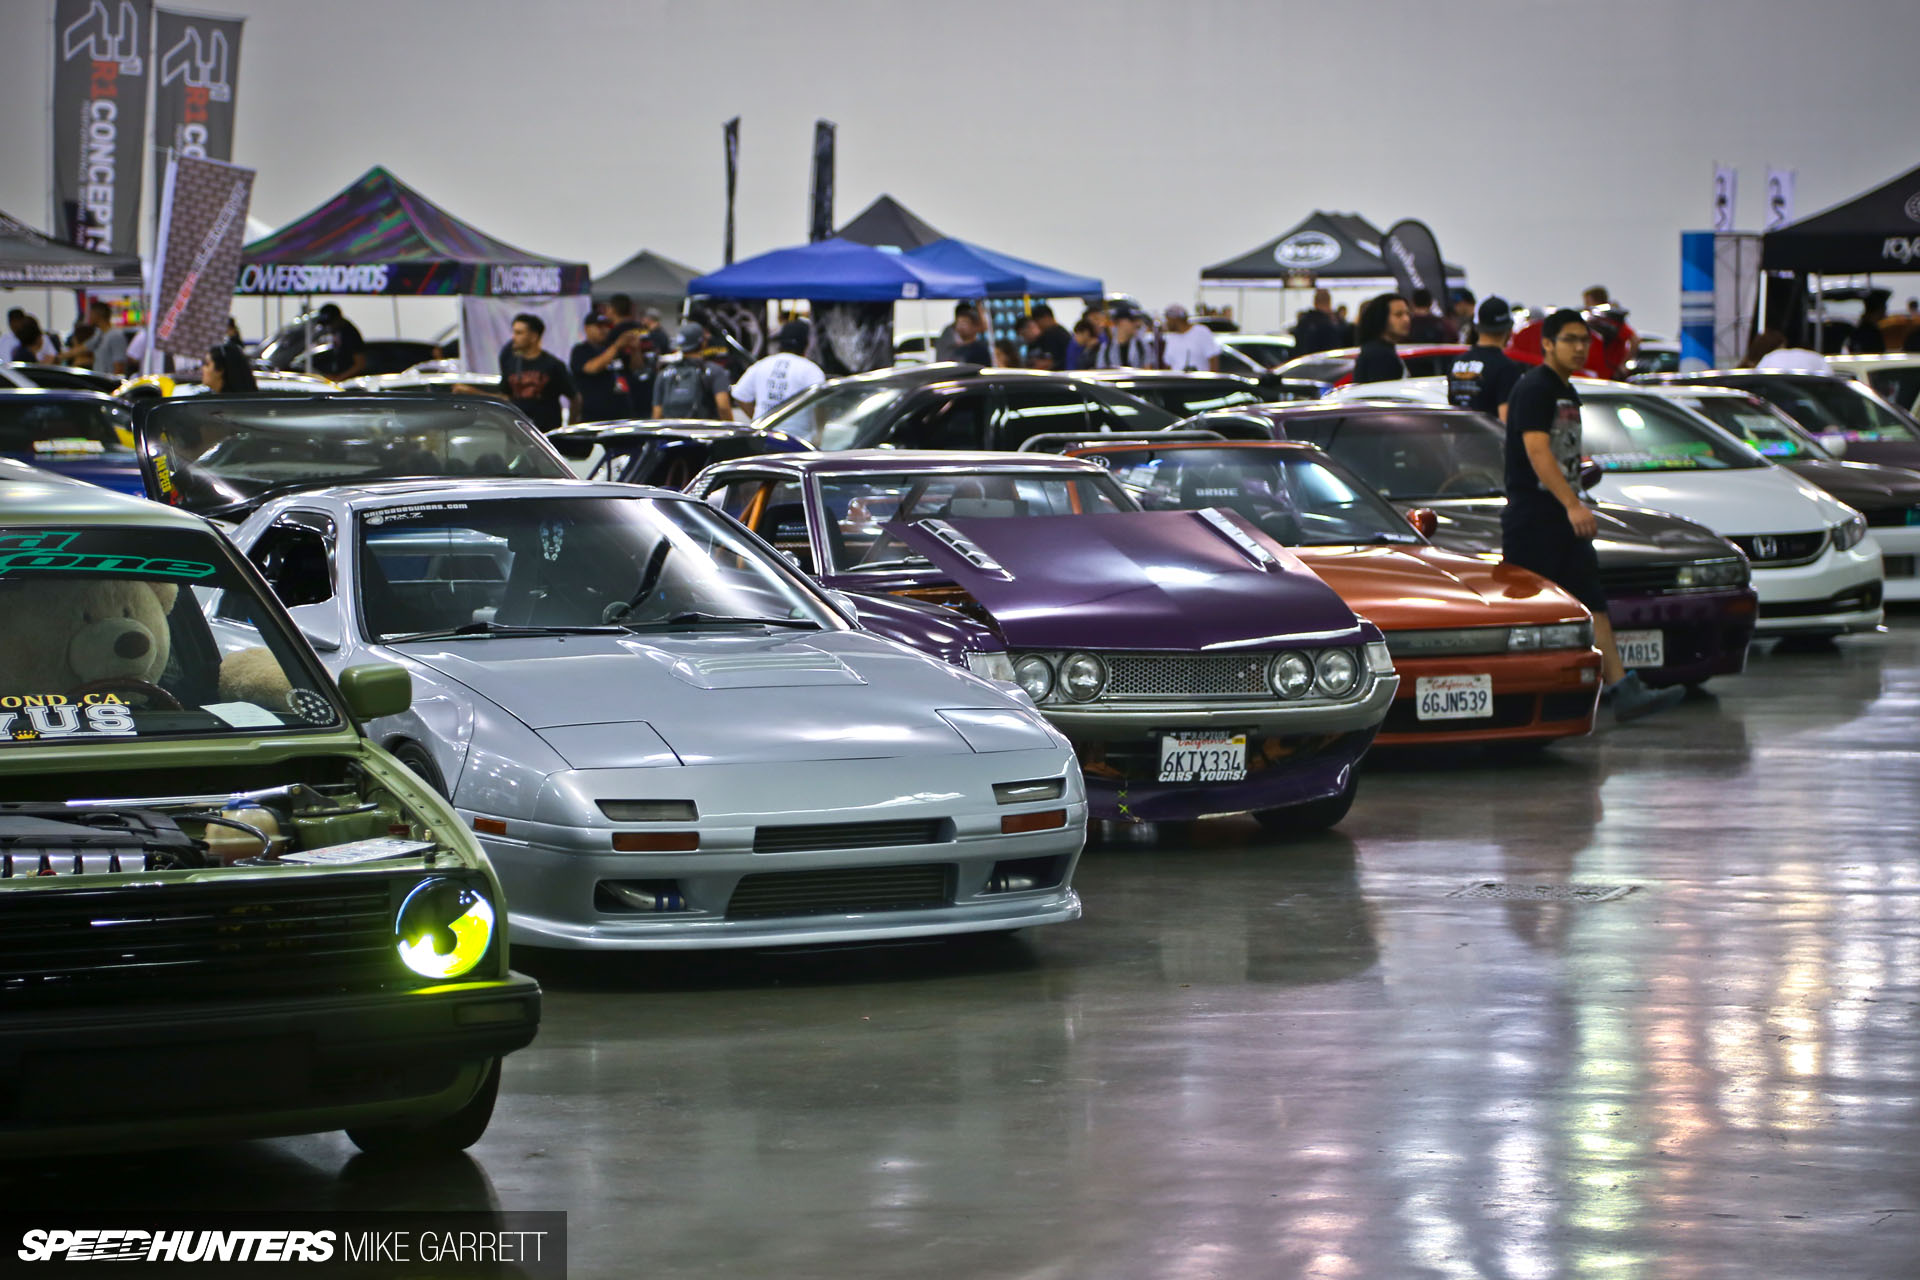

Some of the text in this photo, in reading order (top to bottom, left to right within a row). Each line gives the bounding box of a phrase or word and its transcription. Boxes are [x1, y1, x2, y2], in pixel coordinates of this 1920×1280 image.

[1196, 487, 1239, 497] BRIDE
[1421, 690, 1488, 714] 6GJN539
[1164, 750, 1241, 773] 6KTX334
